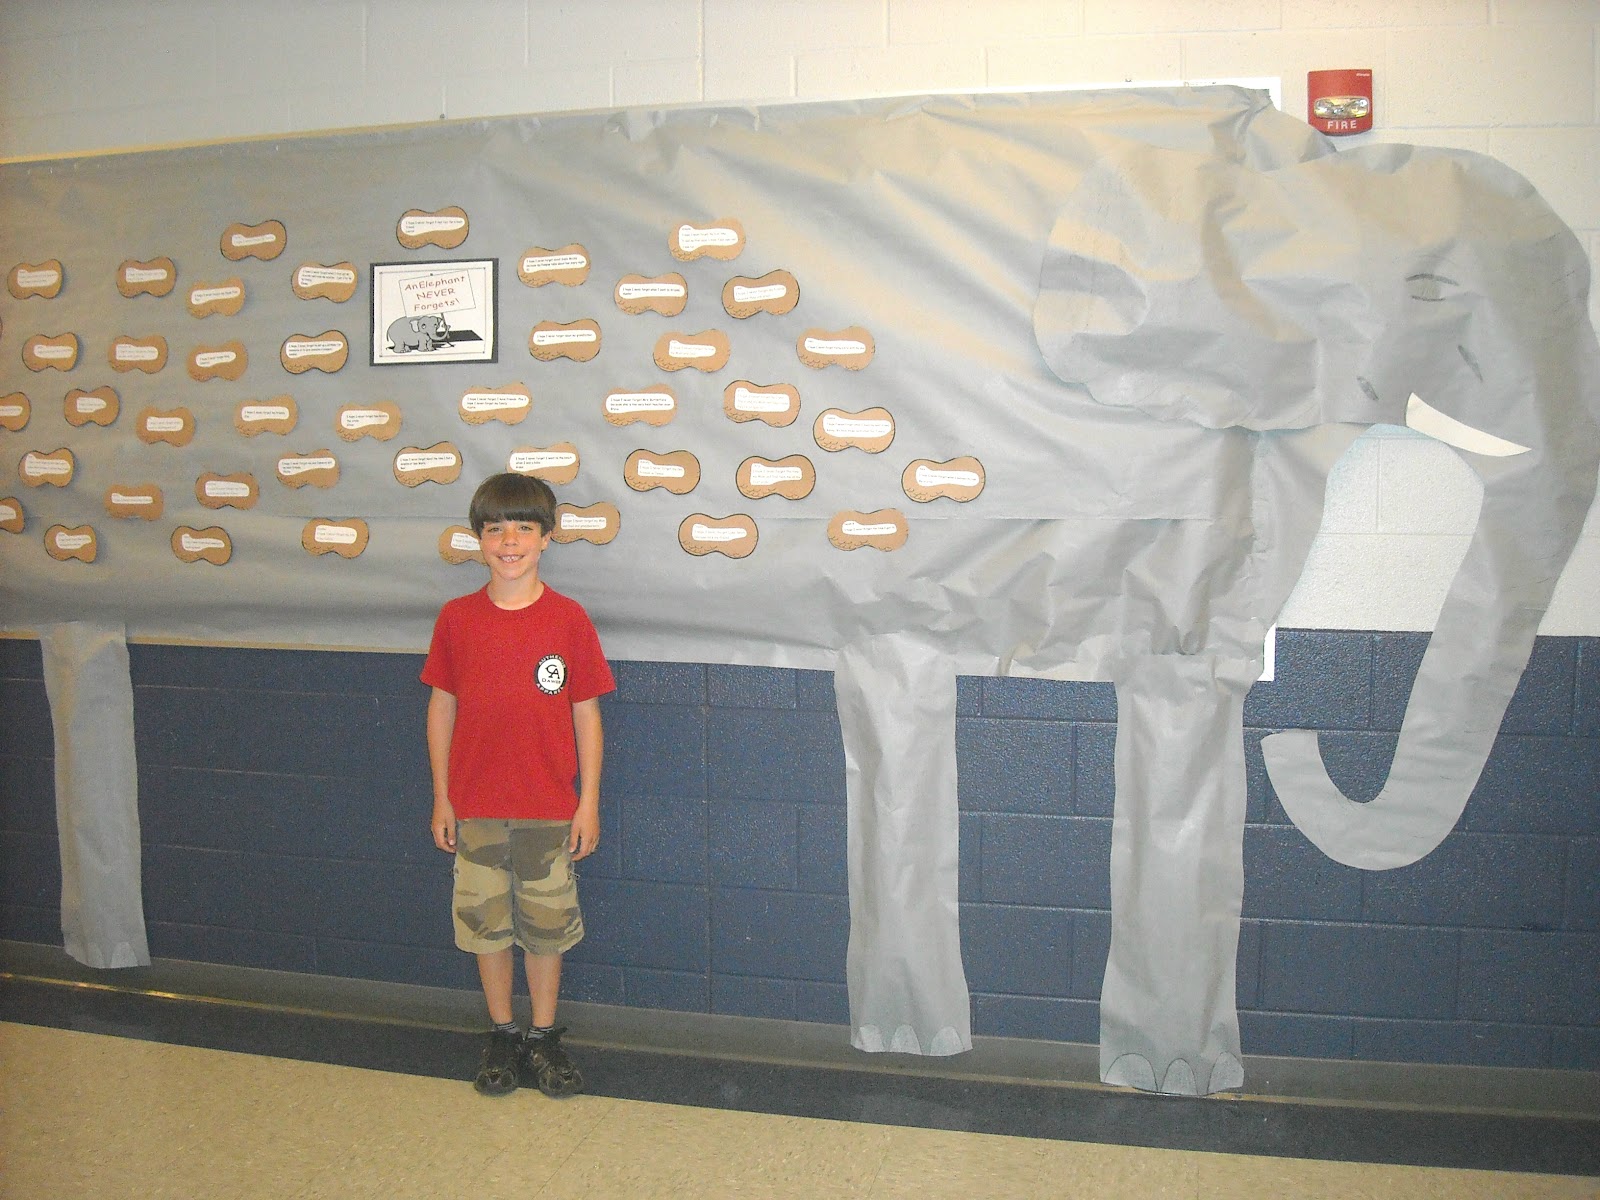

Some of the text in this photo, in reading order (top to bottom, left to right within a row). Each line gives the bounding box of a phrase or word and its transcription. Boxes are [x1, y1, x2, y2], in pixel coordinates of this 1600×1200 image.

[1327, 120, 1357, 130] FIRE
[404, 276, 465, 291] An Elephant
[416, 288, 456, 300] NEVER
